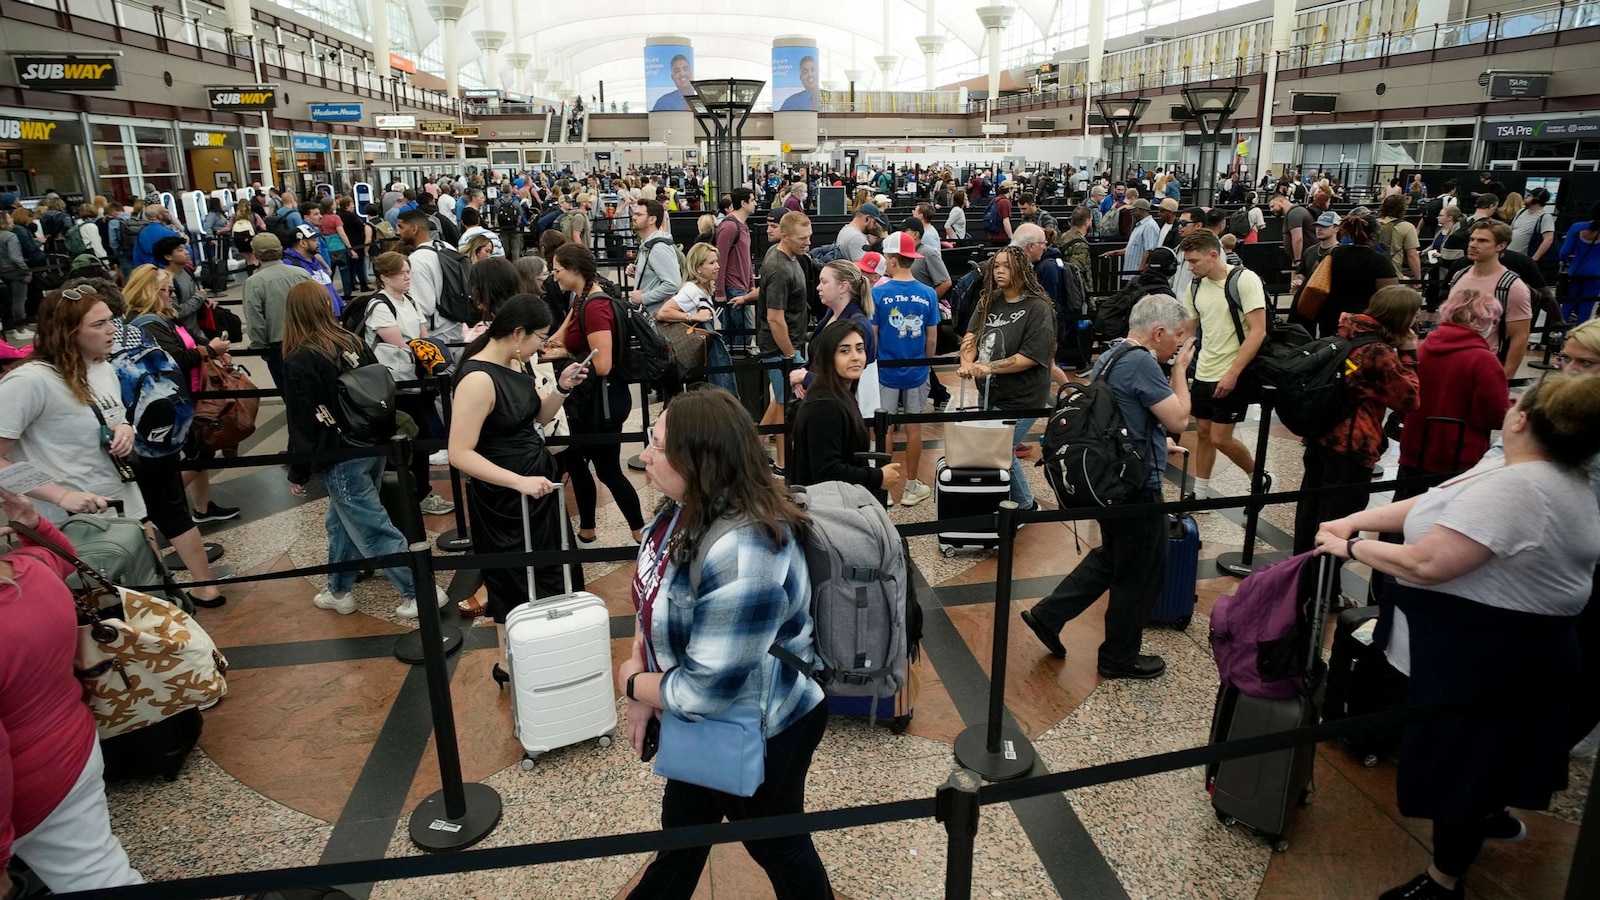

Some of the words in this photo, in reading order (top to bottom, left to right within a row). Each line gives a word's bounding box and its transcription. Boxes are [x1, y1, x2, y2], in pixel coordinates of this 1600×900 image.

[21, 64, 112, 80] SUBWAY
[212, 92, 273, 105] SUBWAY
[0, 120, 56, 140] UBWAY
[1497, 126, 1515, 136] TSA
[1516, 126, 1533, 136] Pre
[193, 132, 227, 147] SUBWAY
